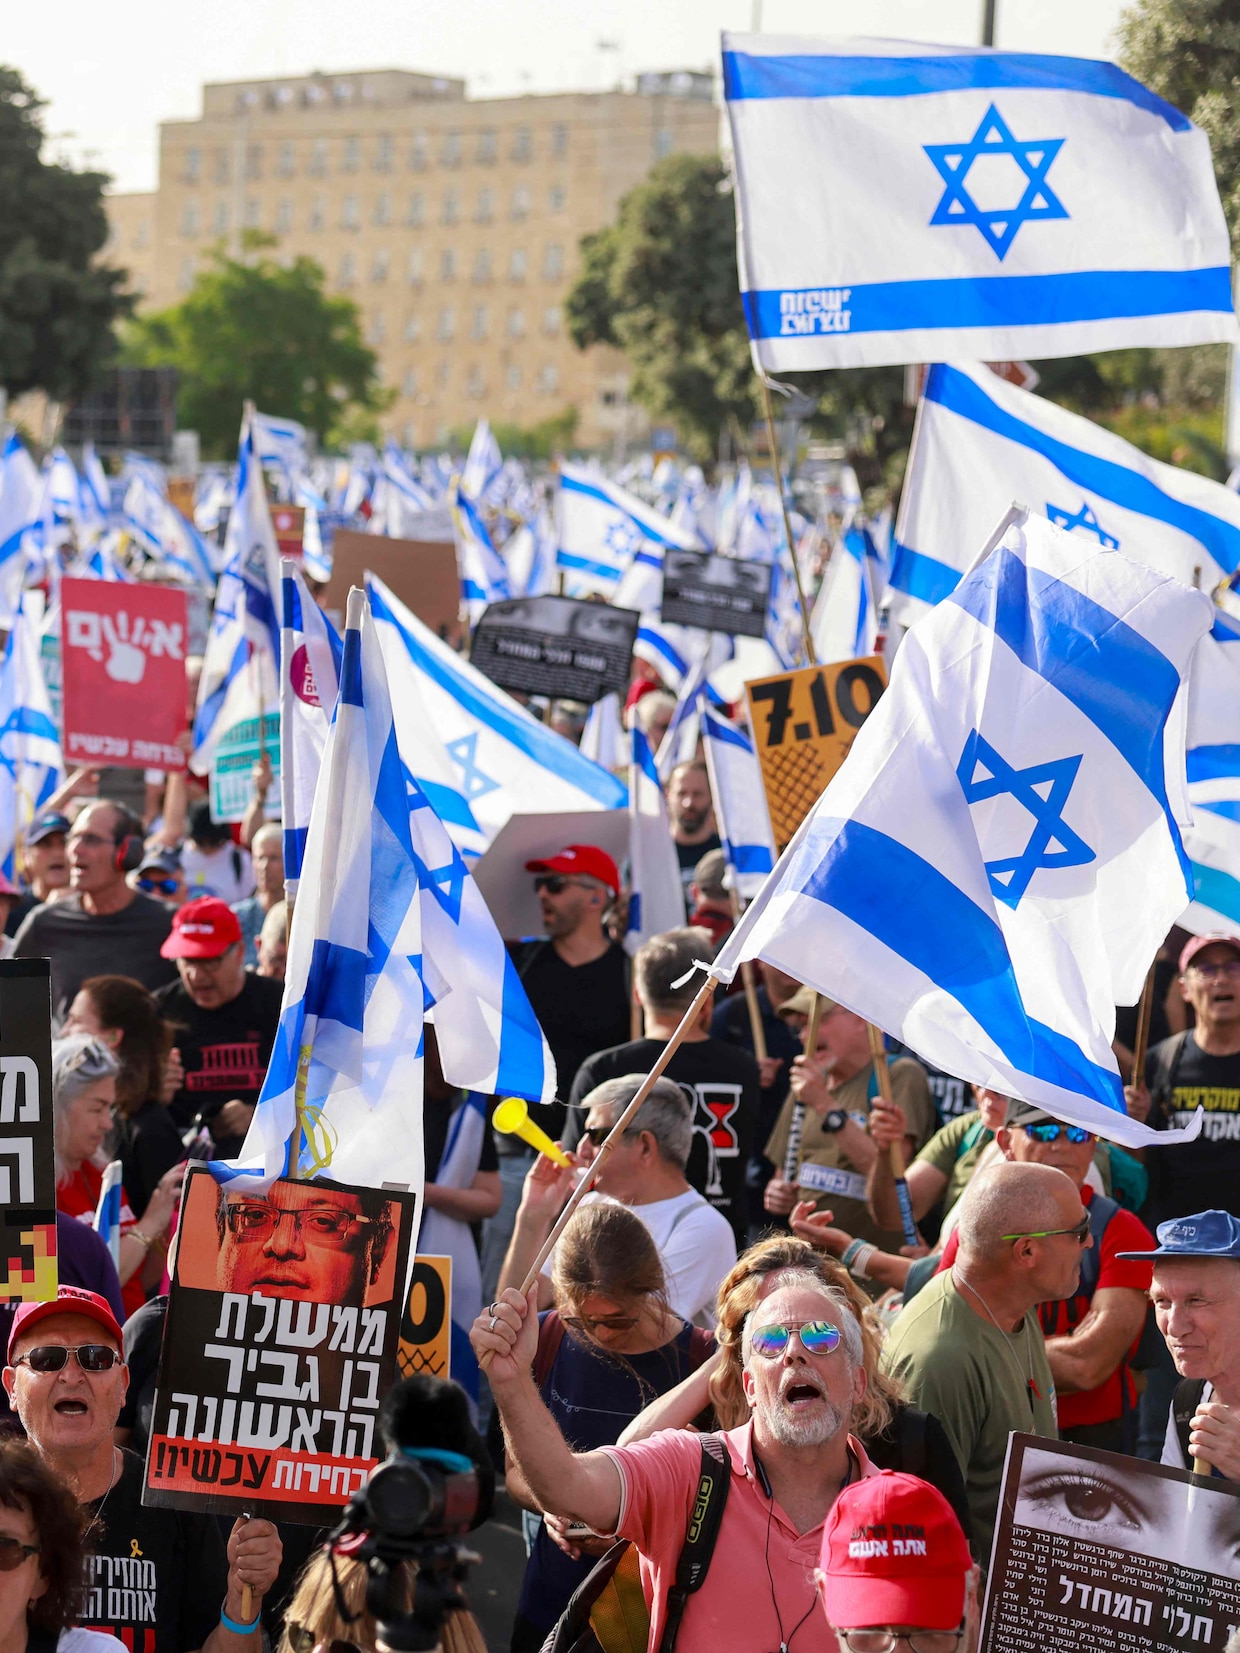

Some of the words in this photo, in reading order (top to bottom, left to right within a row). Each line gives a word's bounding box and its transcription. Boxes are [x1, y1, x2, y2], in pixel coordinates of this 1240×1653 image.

[750, 665, 886, 747] 7.10
[215, 1291, 388, 1356] ממשלת
[204, 1343, 320, 1403] גביר
[340, 1359, 381, 1411] בן
[166, 1393, 376, 1461] הראשונה
[154, 1442, 271, 1489] עכשיו!
[686, 1475, 713, 1543] OGIO
[1012, 1527, 1032, 1538] לירון
[1035, 1532, 1051, 1543] ברד
[1010, 1537, 1027, 1548] סהר
[1052, 1536, 1070, 1547] אלון
[848, 1541, 889, 1558] אשם
[893, 1540, 927, 1556] אתה
[1031, 1542, 1050, 1554] ברוך
[1051, 1547, 1069, 1558] עידן
[1073, 1541, 1106, 1556] ברגשטין
[1037, 1554, 1046, 1564] בן
[1107, 1549, 1125, 1560] שחף
[1128, 1554, 1147, 1566] ברגר
[1090, 1567, 1108, 1579] רומן
[1004, 1578, 1016, 1589] טל
[1140, 1580, 1164, 1593] איתמר
[1002, 1591, 1020, 1601] אדם
[1059, 1574, 1153, 1627] המחדל
[107, 1588, 157, 1622] אותם
[1020, 1606, 1029, 1616] בן
[1217, 1601, 1234, 1613] ברוך
[999, 1612, 1019, 1624] מאיר
[1020, 1615, 1035, 1627] איל
[1069, 1618, 1090, 1629] יעקב
[1037, 1621, 1054, 1633] ברק
[1056, 1626, 1076, 1638] תומר
[1091, 1624, 1114, 1637] אליהו
[996, 1633, 1014, 1644] גבאי
[1078, 1632, 1095, 1643] ברק
[1015, 1638, 1036, 1650] עמית
